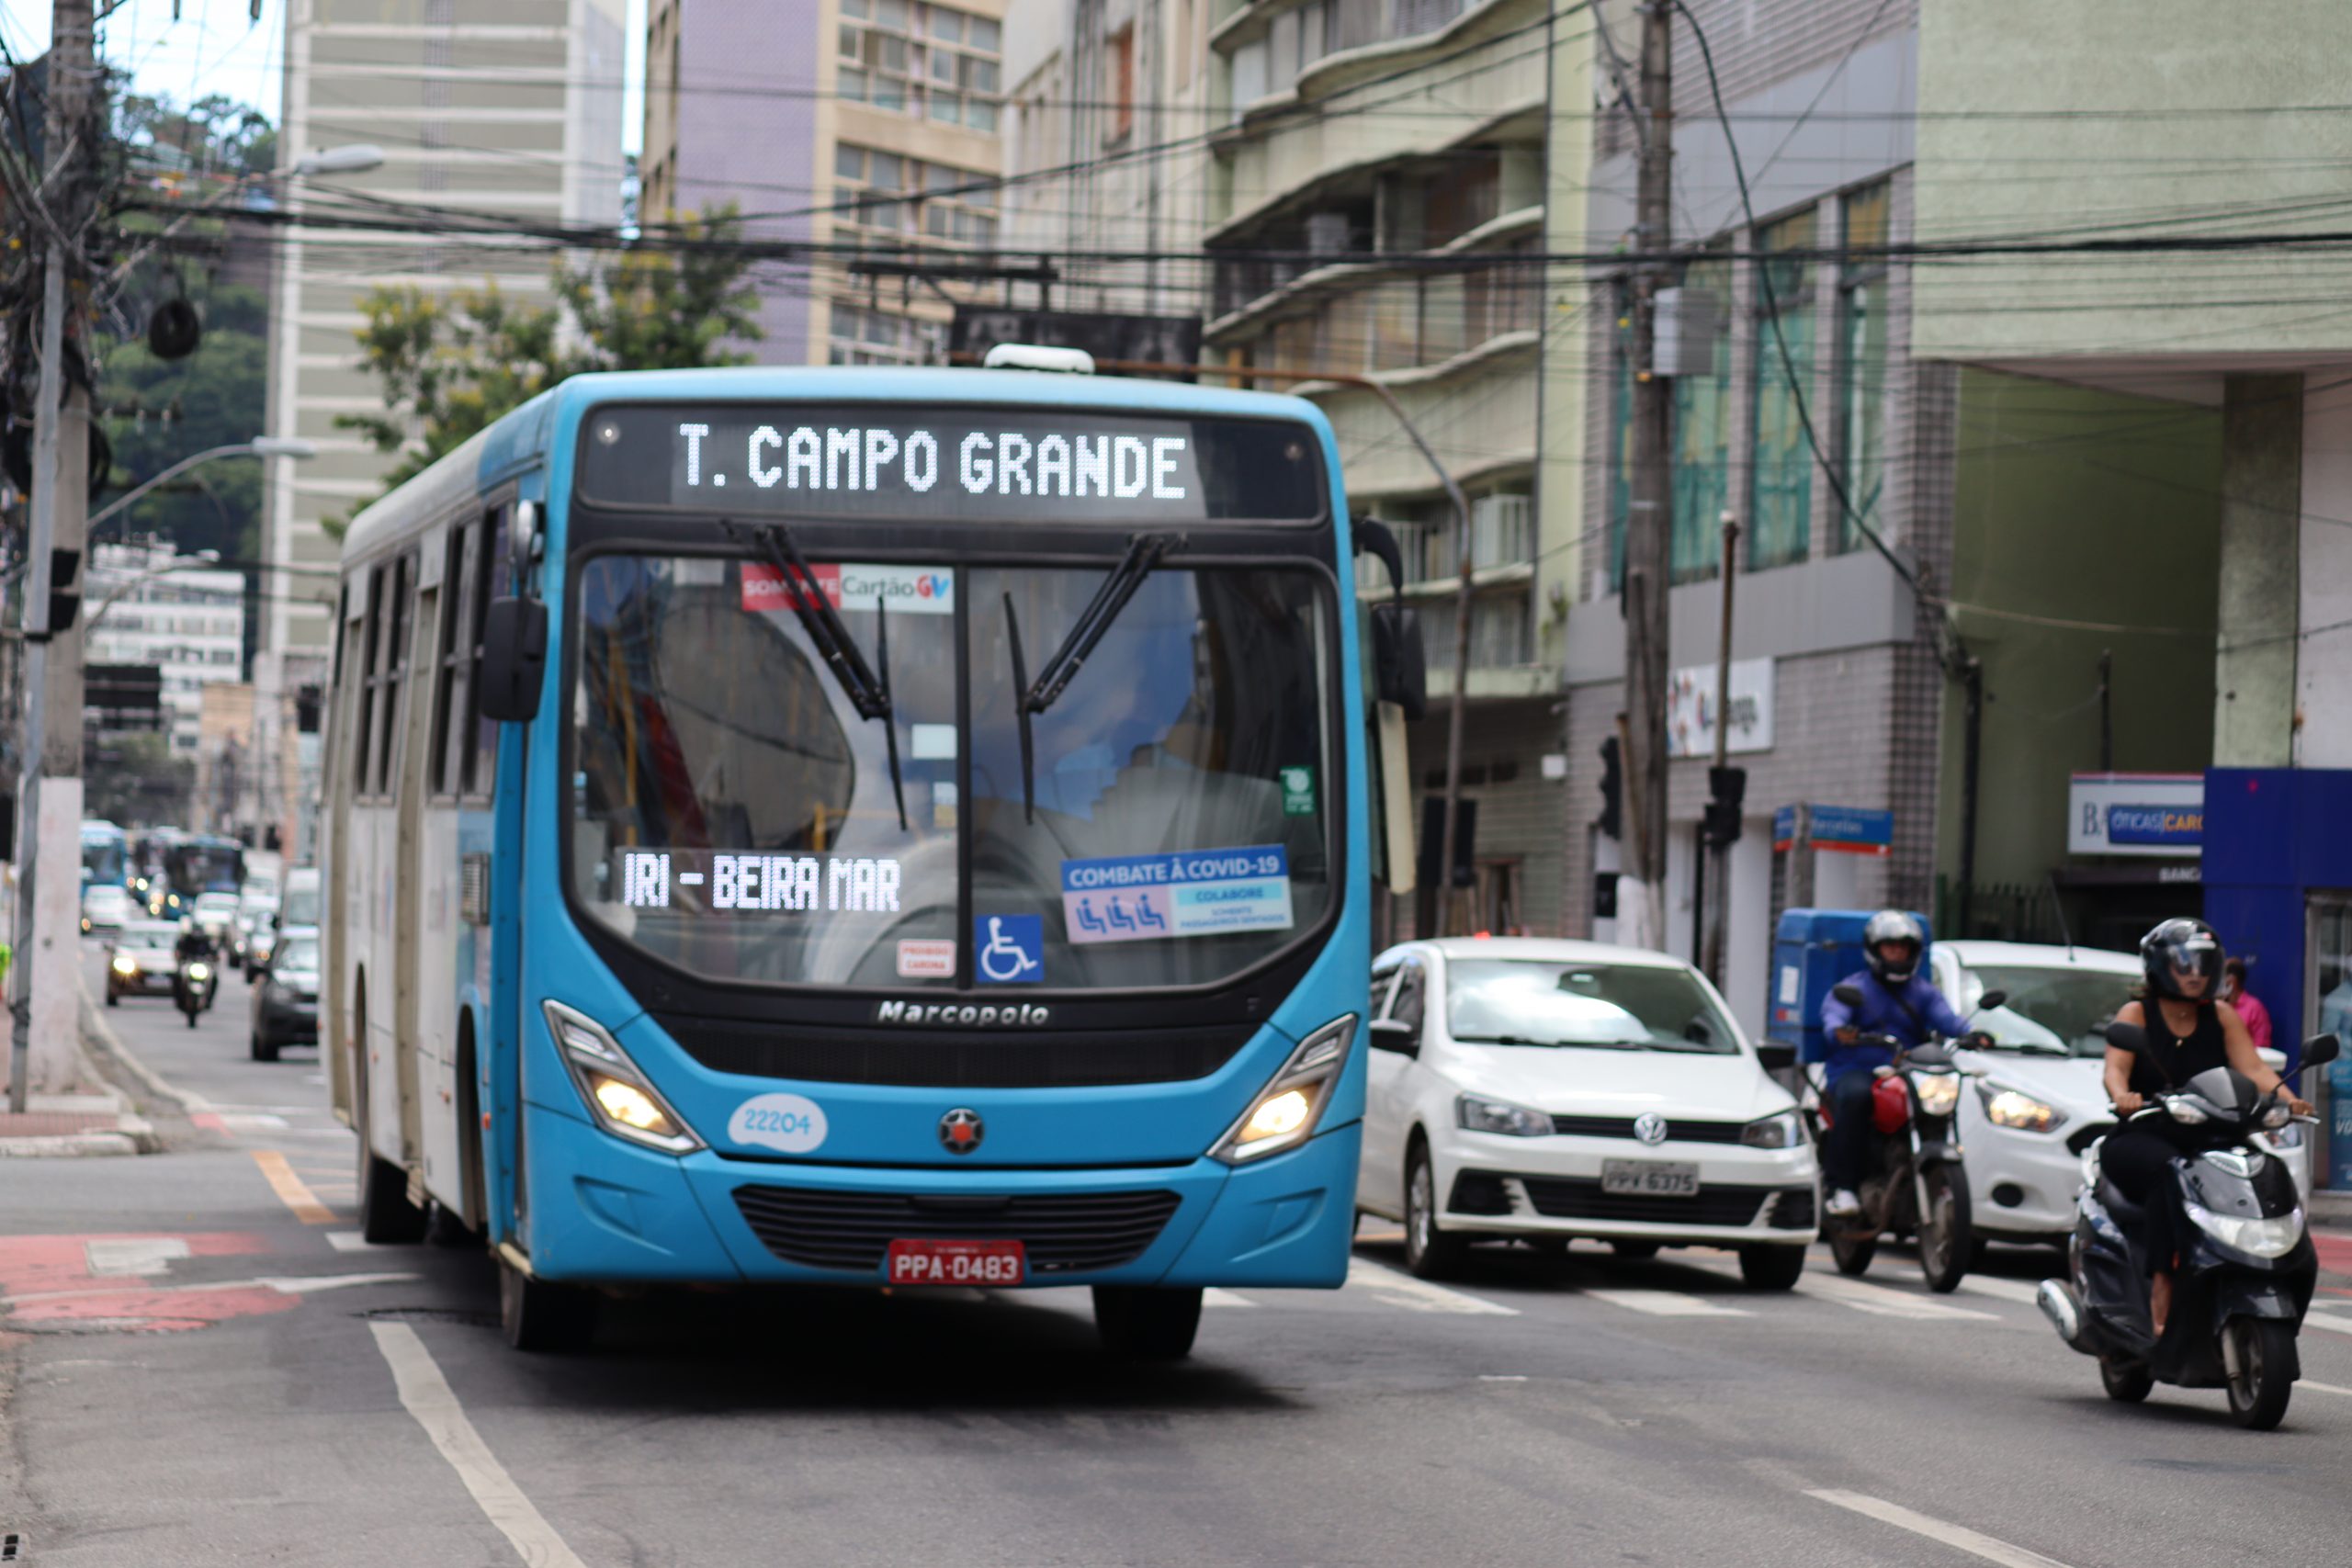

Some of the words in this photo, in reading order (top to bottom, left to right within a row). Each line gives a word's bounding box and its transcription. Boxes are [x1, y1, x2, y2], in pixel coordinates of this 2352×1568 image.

[680, 423, 726, 486] T.
[749, 425, 937, 492] CAMPO
[960, 432, 1186, 499] GRANDE
[713, 855, 820, 909] BEIRA
[829, 858, 900, 911] MAR
[1069, 863, 1168, 888] COMBATE
[1188, 855, 1280, 879] COVID-19
[1196, 886, 1264, 903] COLABORE
[877, 1000, 1049, 1026] Marcopolo
[743, 1109, 811, 1135] 22204
